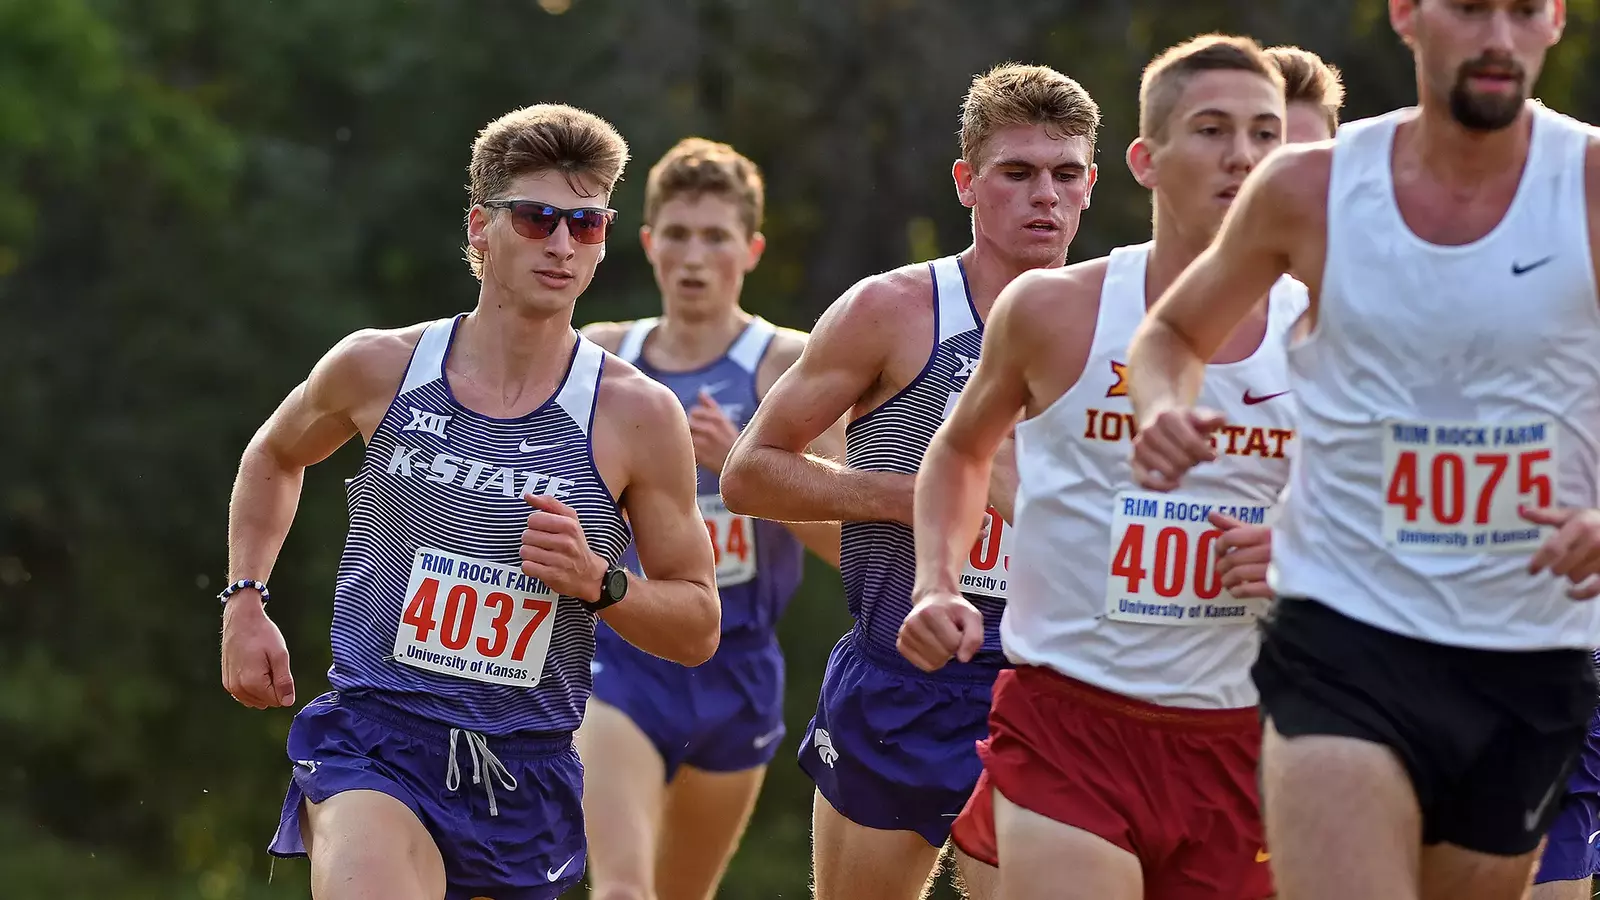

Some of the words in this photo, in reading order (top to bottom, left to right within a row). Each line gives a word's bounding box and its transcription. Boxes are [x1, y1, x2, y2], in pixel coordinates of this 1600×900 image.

[1084, 408, 1138, 442] IO
[1393, 424, 1430, 445] RIM
[1435, 426, 1486, 446] ROCK
[1494, 423, 1546, 446] FARM
[386, 445, 576, 499] K-STATE
[1386, 448, 1553, 525] 4075
[1123, 497, 1159, 519] RIM
[1163, 502, 1212, 522] ROCK
[1396, 528, 1468, 546] University
[1472, 531, 1487, 546] of
[1491, 527, 1541, 544] Kansas
[420, 552, 455, 577] RIM
[457, 560, 504, 587] ROCK
[505, 571, 551, 596] FARM
[1111, 523, 1227, 600] 400
[402, 576, 553, 662] 4037
[1118, 599, 1185, 620] University
[1188, 604, 1201, 618] of
[1203, 604, 1247, 618] Kansas
[406, 644, 468, 672] University
[470, 658, 484, 673] of
[485, 661, 528, 681] Kansas
